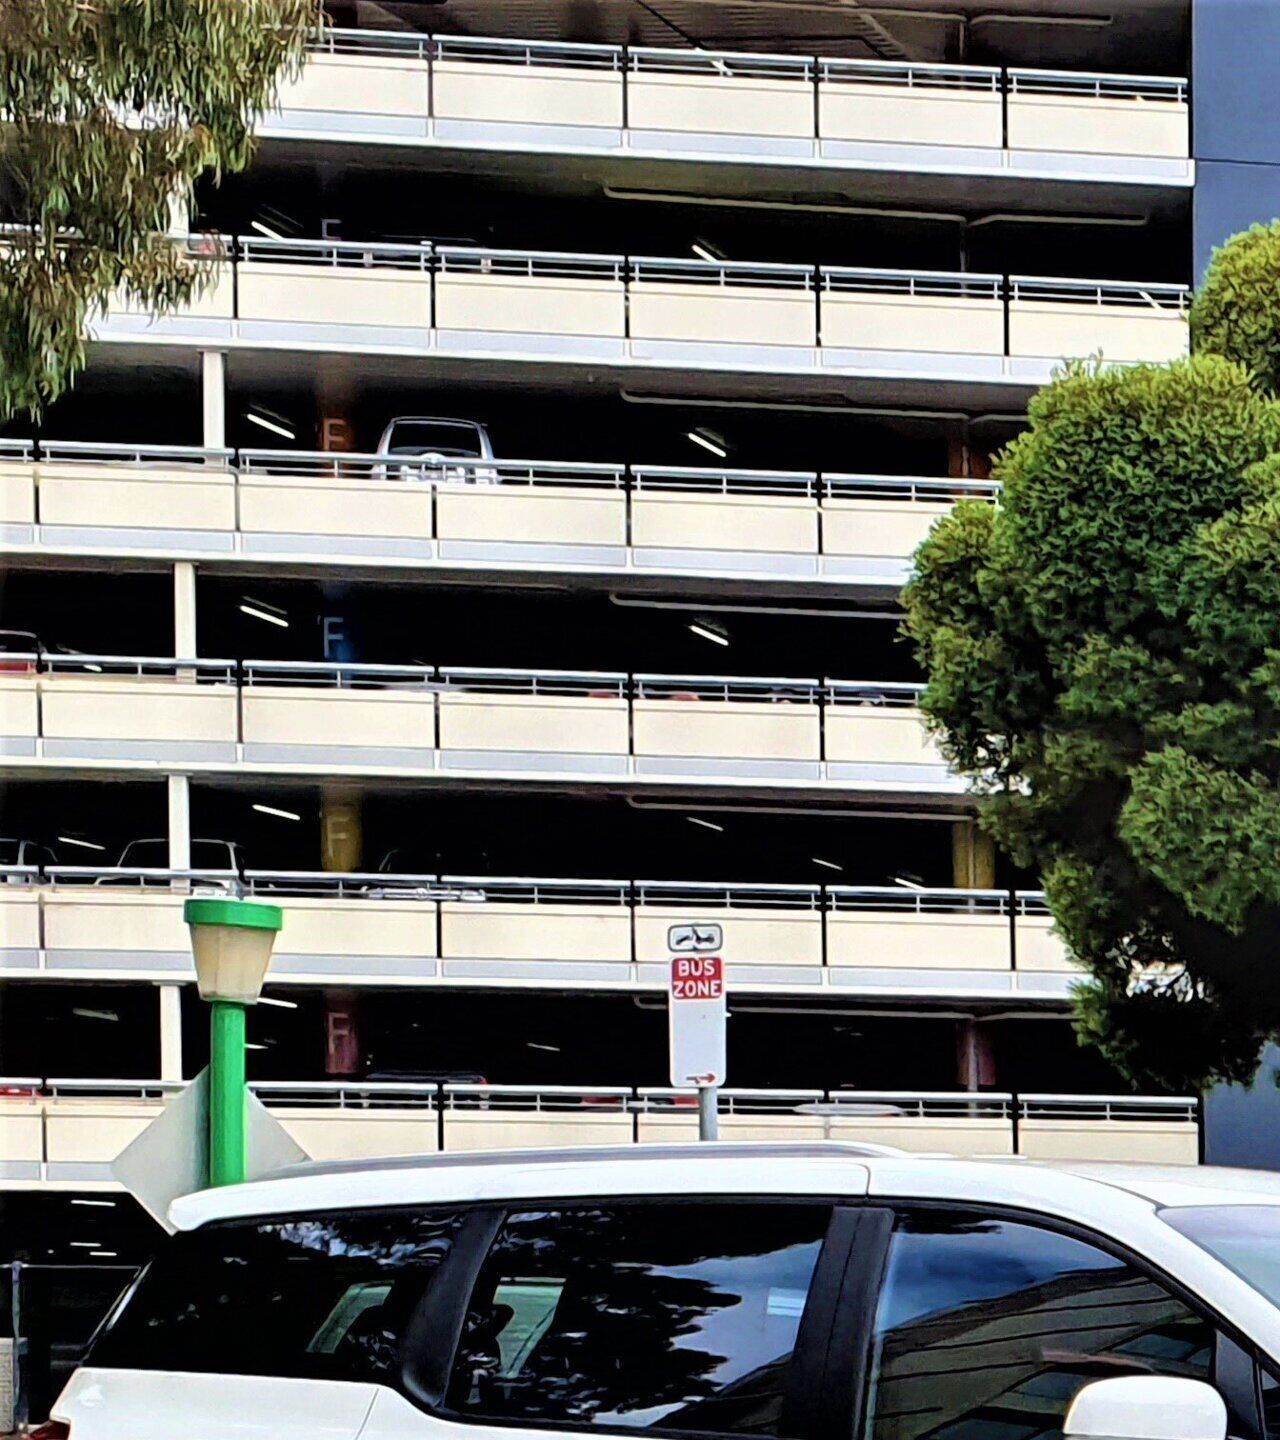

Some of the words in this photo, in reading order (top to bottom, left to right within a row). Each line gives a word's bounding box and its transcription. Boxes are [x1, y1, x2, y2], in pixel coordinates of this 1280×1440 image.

[323, 616, 344, 659] F
[678, 960, 715, 977] BUS
[673, 979, 721, 998] ZONE
